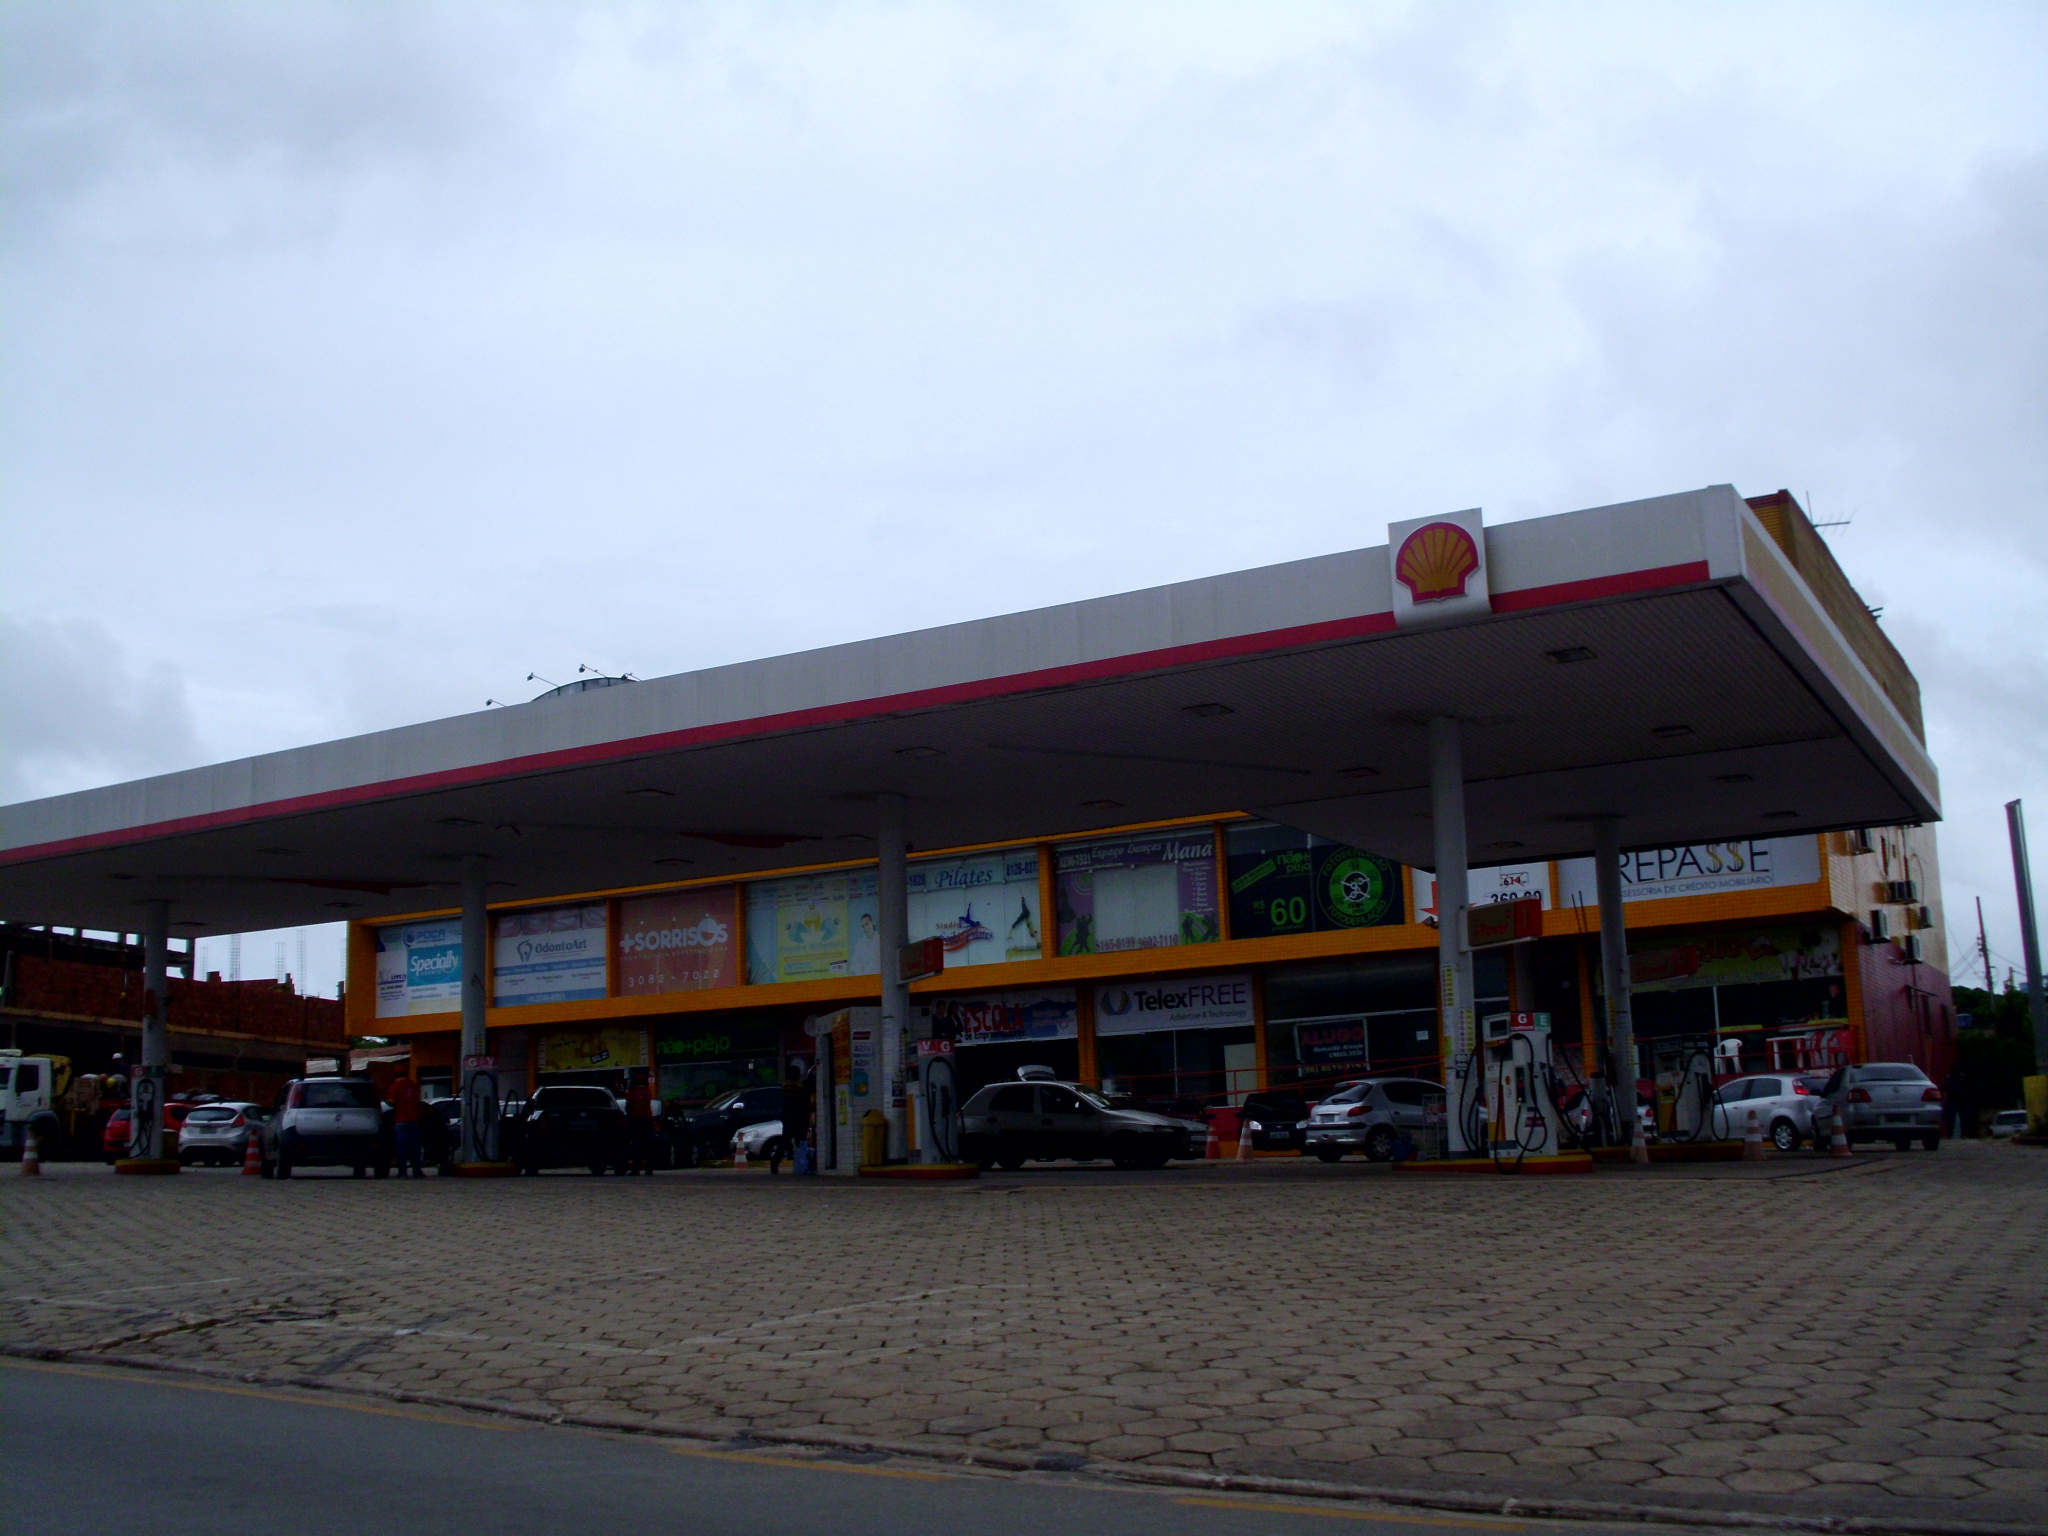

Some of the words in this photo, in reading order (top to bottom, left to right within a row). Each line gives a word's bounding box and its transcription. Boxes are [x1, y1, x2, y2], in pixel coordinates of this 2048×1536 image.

[1162, 838, 1213, 862] Maná
[935, 866, 993, 888] Pilates
[1270, 896, 1307, 926] 60
[535, 939, 588, 954] OdontoArt
[410, 950, 459, 977] Specially
[1134, 982, 1246, 1013] TelexFREE
[964, 1003, 1024, 1033] ESCOLA
[1517, 1013, 1528, 1024] G
[921, 1040, 931, 1051] V
[940, 1040, 951, 1052] G
[1300, 1026, 1365, 1047] ALUGO
[467, 1057, 478, 1067] G
